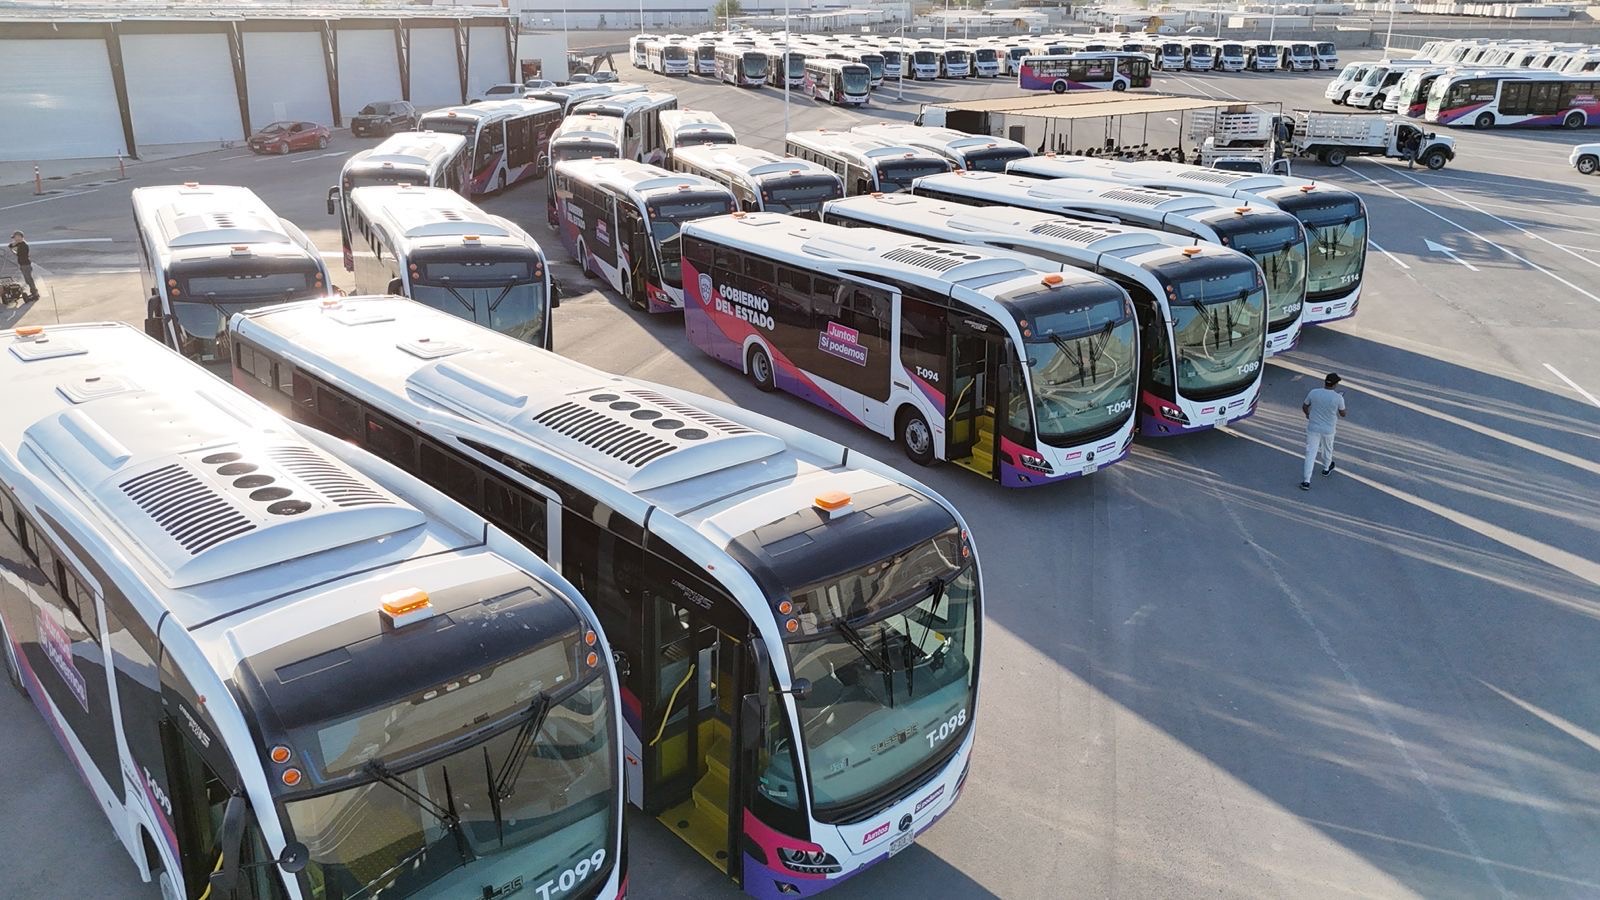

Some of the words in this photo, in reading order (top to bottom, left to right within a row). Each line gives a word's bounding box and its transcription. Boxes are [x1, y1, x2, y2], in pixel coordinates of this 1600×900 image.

[1341, 273, 1359, 284] T-114
[720, 284, 769, 313] GOBIERNO
[716, 297, 733, 316] DEL
[735, 305, 775, 331] ESTADO
[829, 326, 856, 343] Juntos
[829, 341, 865, 361] podemos
[916, 366, 939, 382] T-094
[1237, 361, 1259, 375] T-089
[1106, 399, 1131, 415] T-094
[926, 708, 966, 748] T-098
[143, 766, 172, 816] T-099
[536, 849, 606, 900] T-099
